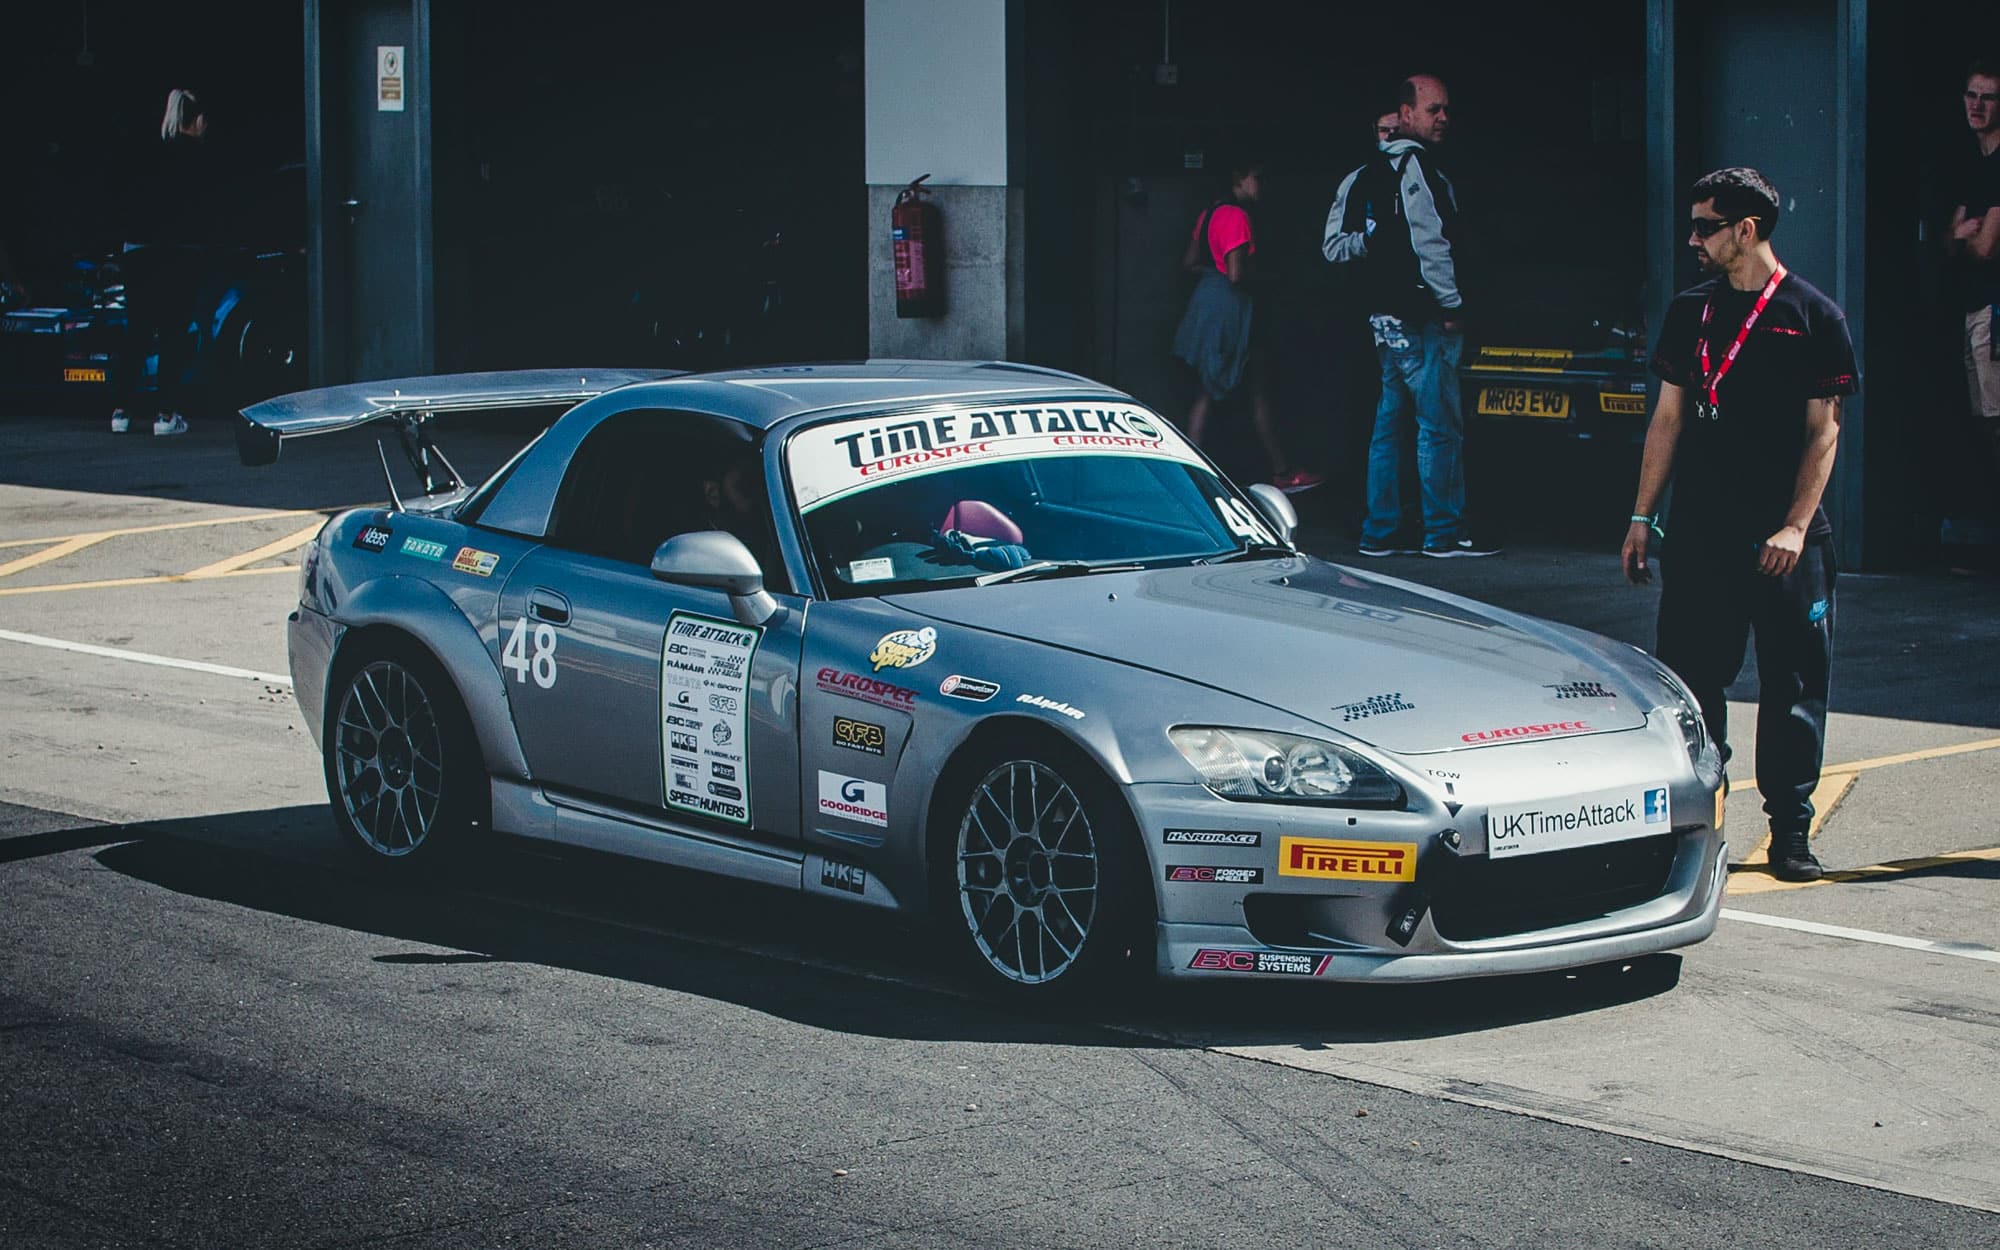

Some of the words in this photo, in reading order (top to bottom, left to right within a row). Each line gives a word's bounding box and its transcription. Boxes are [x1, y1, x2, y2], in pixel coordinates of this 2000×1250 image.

[970, 408, 1131, 440] ATTACK
[1053, 435, 1165, 450] EUROSPEC
[860, 442, 994, 476] EUROSPEC
[1215, 497, 1277, 546] 48
[403, 538, 444, 558] TAKATA
[502, 616, 557, 689] 48
[668, 643, 688, 655] BC
[816, 667, 920, 705] EUROSPEC
[666, 715, 684, 727] BC
[671, 731, 697, 748] HKS
[835, 719, 883, 746] GFB
[1461, 721, 1592, 743] EUROSPEC
[1426, 768, 1461, 780] TOW
[820, 799, 888, 820] GOODRIDGE
[1492, 798, 1637, 840] UKTimeAttack
[1167, 832, 1258, 844] HARDRACE
[1290, 844, 1405, 875] PIRELLI
[823, 860, 864, 885] HKS
[1170, 867, 1215, 881] BC
[1191, 950, 1254, 970] BC
[1259, 954, 1311, 963] SUSPENSION
[1258, 961, 1311, 973] SYSTEMS
